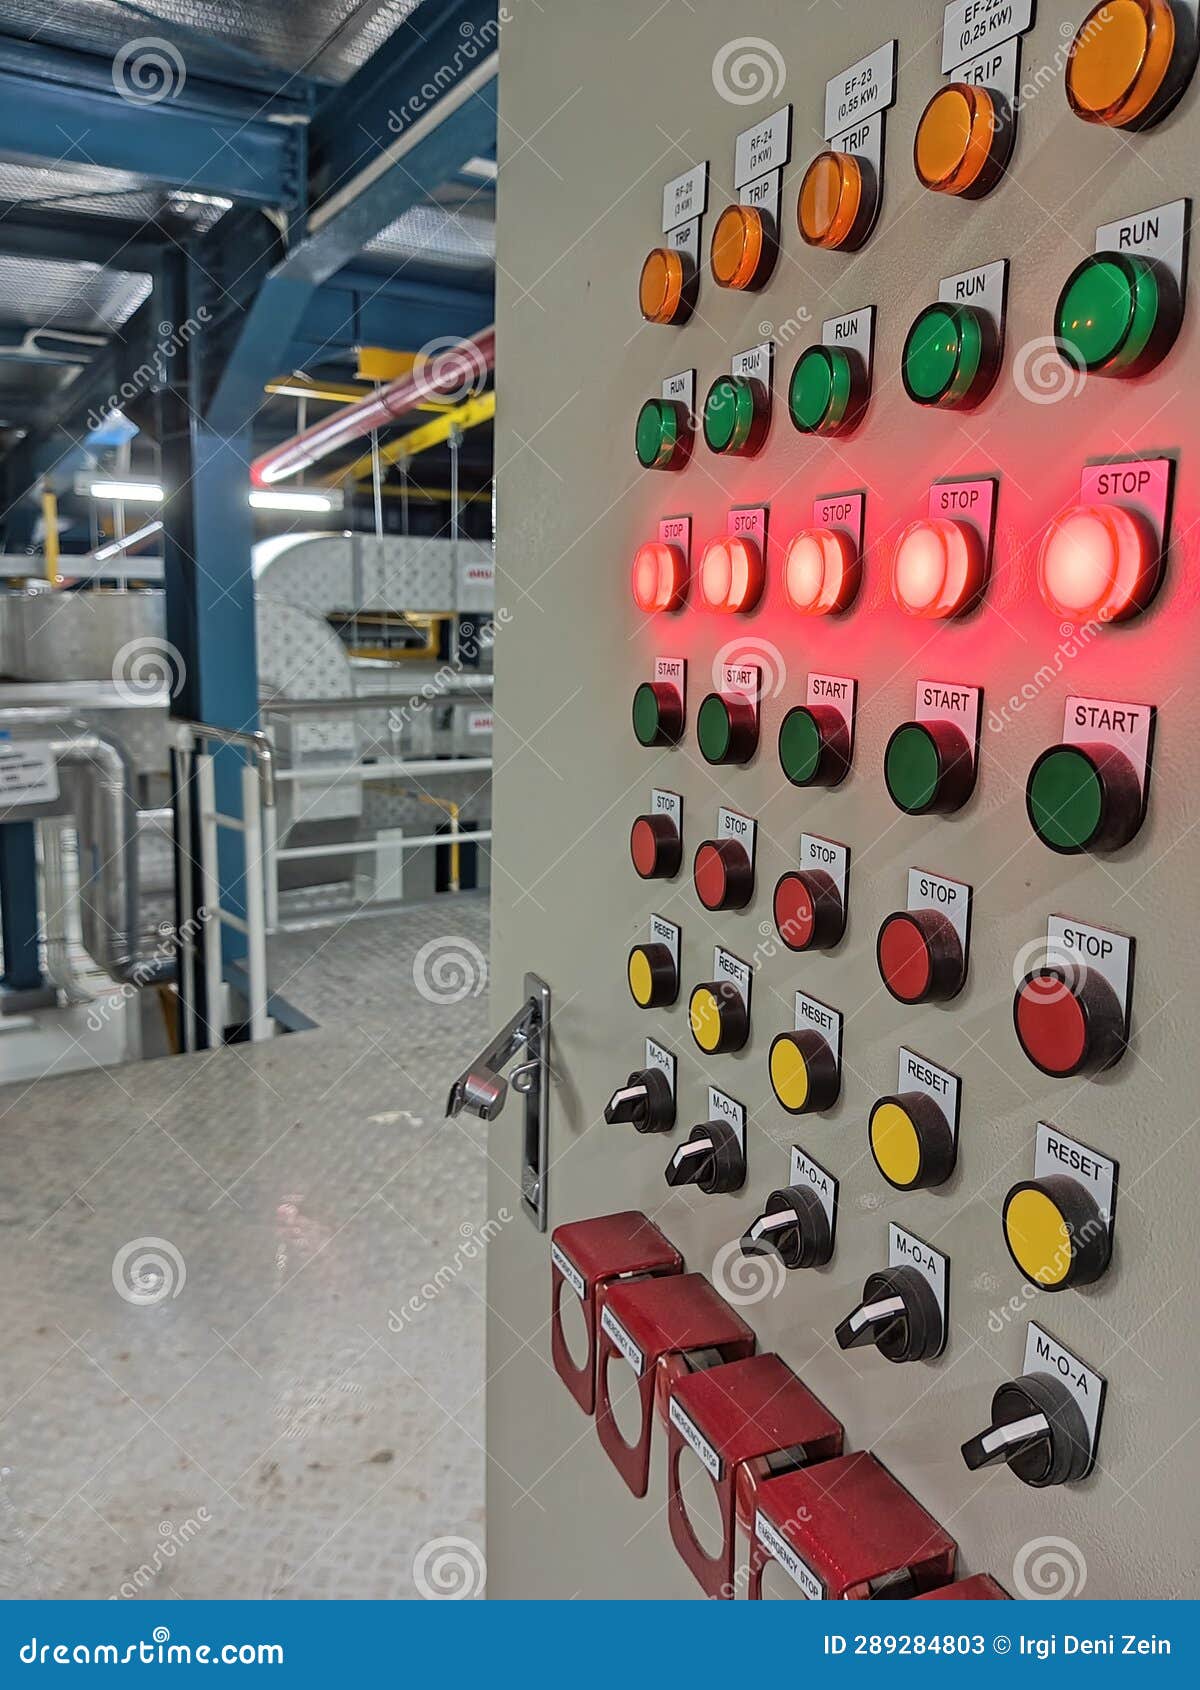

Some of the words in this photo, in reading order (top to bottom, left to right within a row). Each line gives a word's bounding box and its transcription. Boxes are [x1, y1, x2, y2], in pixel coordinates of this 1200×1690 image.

[964, 0, 1004, 24] EF-22
[960, 20, 986, 51] (0,25
[989, 6, 1012, 31] KW)
[845, 68, 872, 96] EF-23
[964, 56, 1002, 85] TRIP
[838, 96, 859, 120] (0,55
[860, 84, 878, 105] KW)
[751, 128, 772, 151] RF-24
[841, 125, 870, 153] TRIP
[758, 146, 772, 163] KW)
[749, 182, 769, 204] TRIP
[675, 228, 691, 246] TRIP
[1119, 216, 1159, 249] RUN
[956, 274, 985, 300] RUN
[835, 318, 858, 339] RUN
[742, 353, 760, 372] RUN
[670, 378, 685, 395] RUN
[1097, 470, 1151, 495] STOP
[940, 490, 979, 509] STOP
[734, 515, 758, 531] STOP
[822, 503, 852, 522] STOP
[664, 523, 683, 538] STOP
[658, 662, 680, 676] START
[726, 669, 751, 685] START
[813, 679, 848, 699] START
[924, 688, 970, 712] START
[1075, 705, 1139, 733] START
[657, 795, 675, 811] STOP
[725, 816, 747, 835] STOP
[810, 843, 836, 864] STOP
[920, 878, 957, 905] STOP
[654, 921, 675, 941] RESET
[1063, 929, 1113, 959] STOP
[719, 955, 745, 981] RESET
[801, 1002, 833, 1030] RESET
[908, 1059, 949, 1095] RESET
[713, 1094, 738, 1121] M-O-A
[1047, 1137, 1102, 1181] RESET
[796, 1156, 828, 1195] M-O-A
[896, 1234, 937, 1275] M-O-A
[1036, 1336, 1088, 1395] M-O-A
[758, 1521, 798, 1573] EMERGENCY
[801, 1570, 819, 1597] STOP
